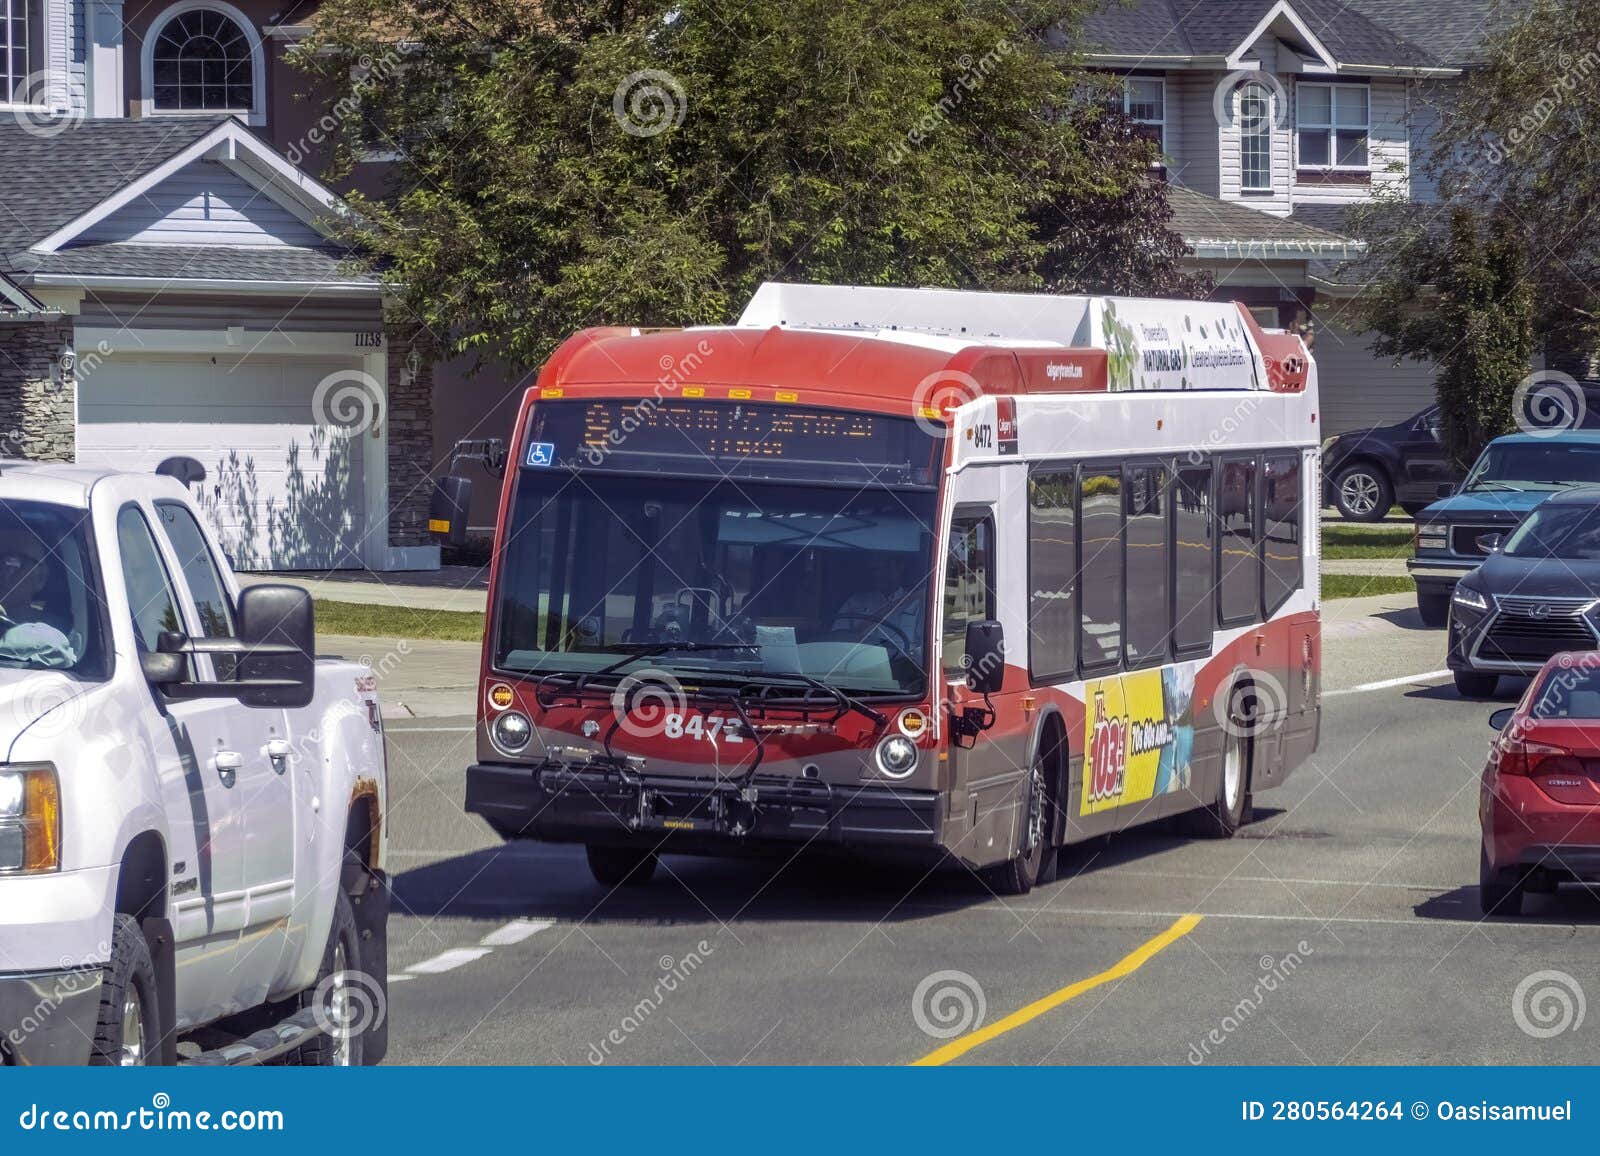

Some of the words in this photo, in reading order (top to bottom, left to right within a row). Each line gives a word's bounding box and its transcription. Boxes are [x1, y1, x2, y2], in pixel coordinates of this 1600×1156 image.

[355, 331, 381, 347] 11138
[1143, 350, 1169, 371] NATURAL
[1170, 349, 1182, 371] GAS
[974, 423, 992, 448] 8472
[664, 713, 744, 743] 8472
